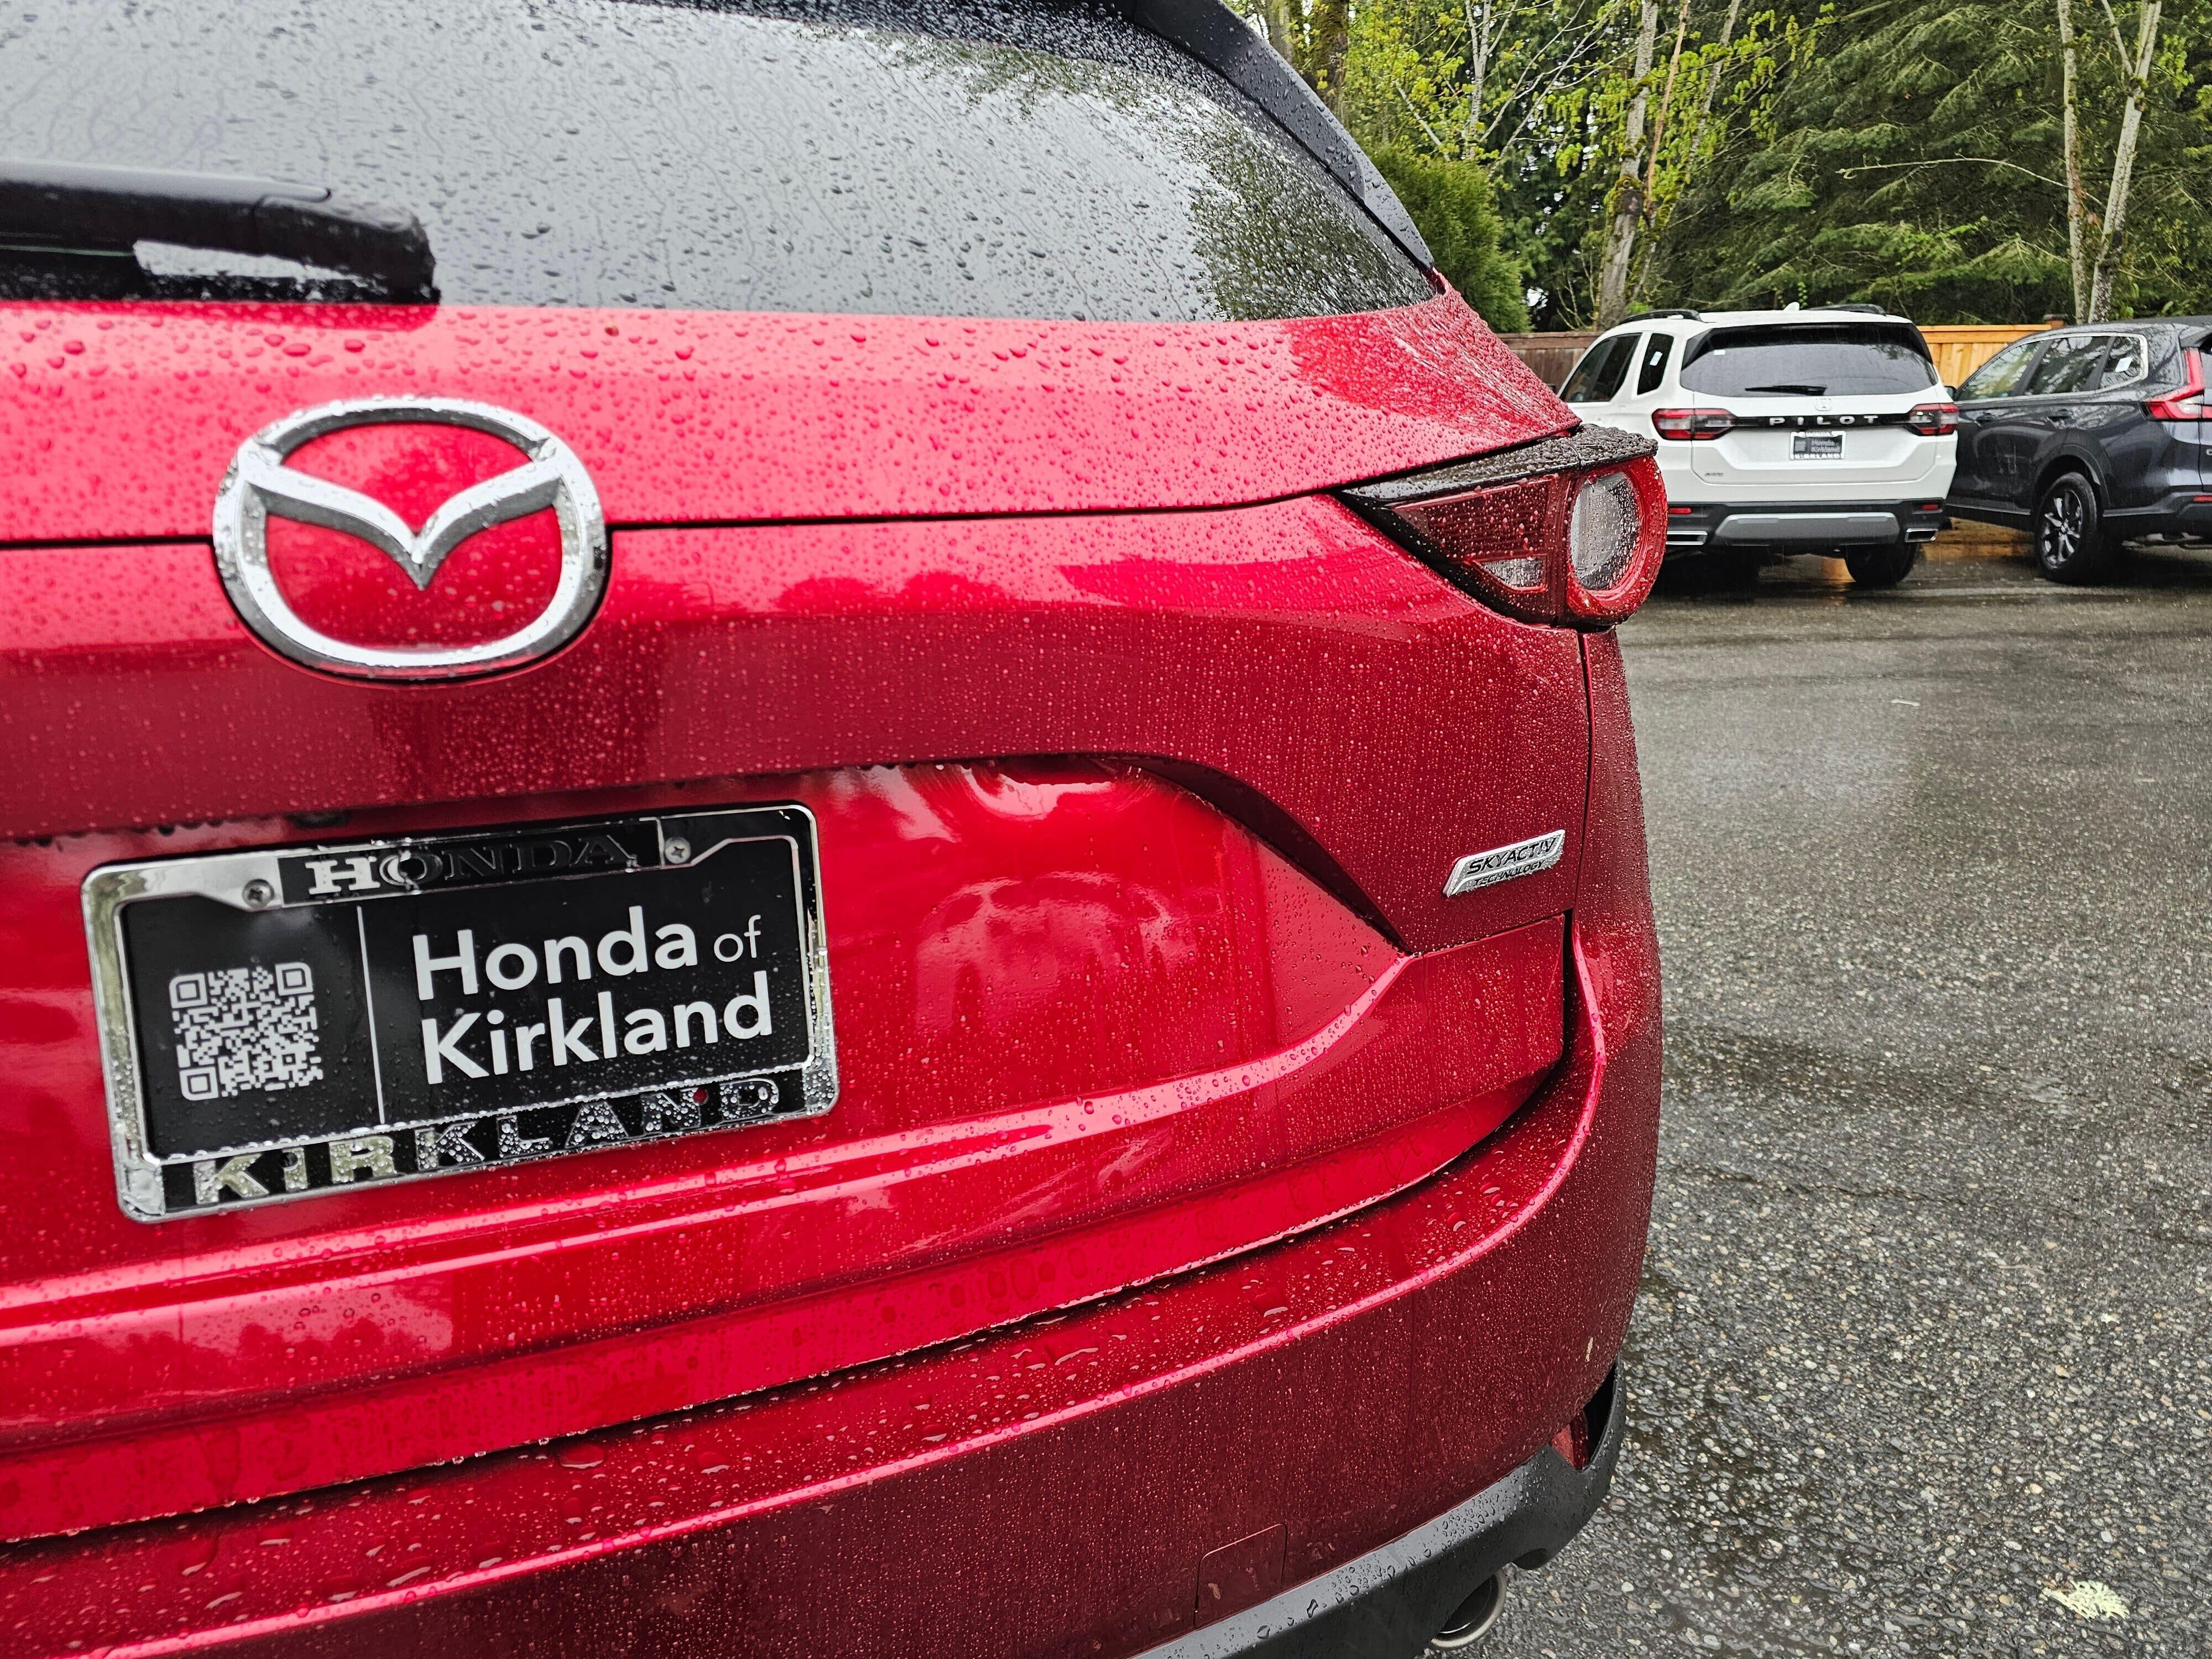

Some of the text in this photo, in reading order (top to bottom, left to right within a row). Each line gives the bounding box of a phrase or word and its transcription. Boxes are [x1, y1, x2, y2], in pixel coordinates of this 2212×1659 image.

[1769, 415, 1877, 426] PILOT
[304, 834, 638, 895] HONDA
[1466, 837, 1557, 875] SKYACTIV
[1474, 859, 1546, 886] TECHNOLOGY
[413, 905, 761, 1001] Honda of
[421, 971, 773, 1084] Kirkland
[192, 1077, 780, 1205] KIRKLAND
